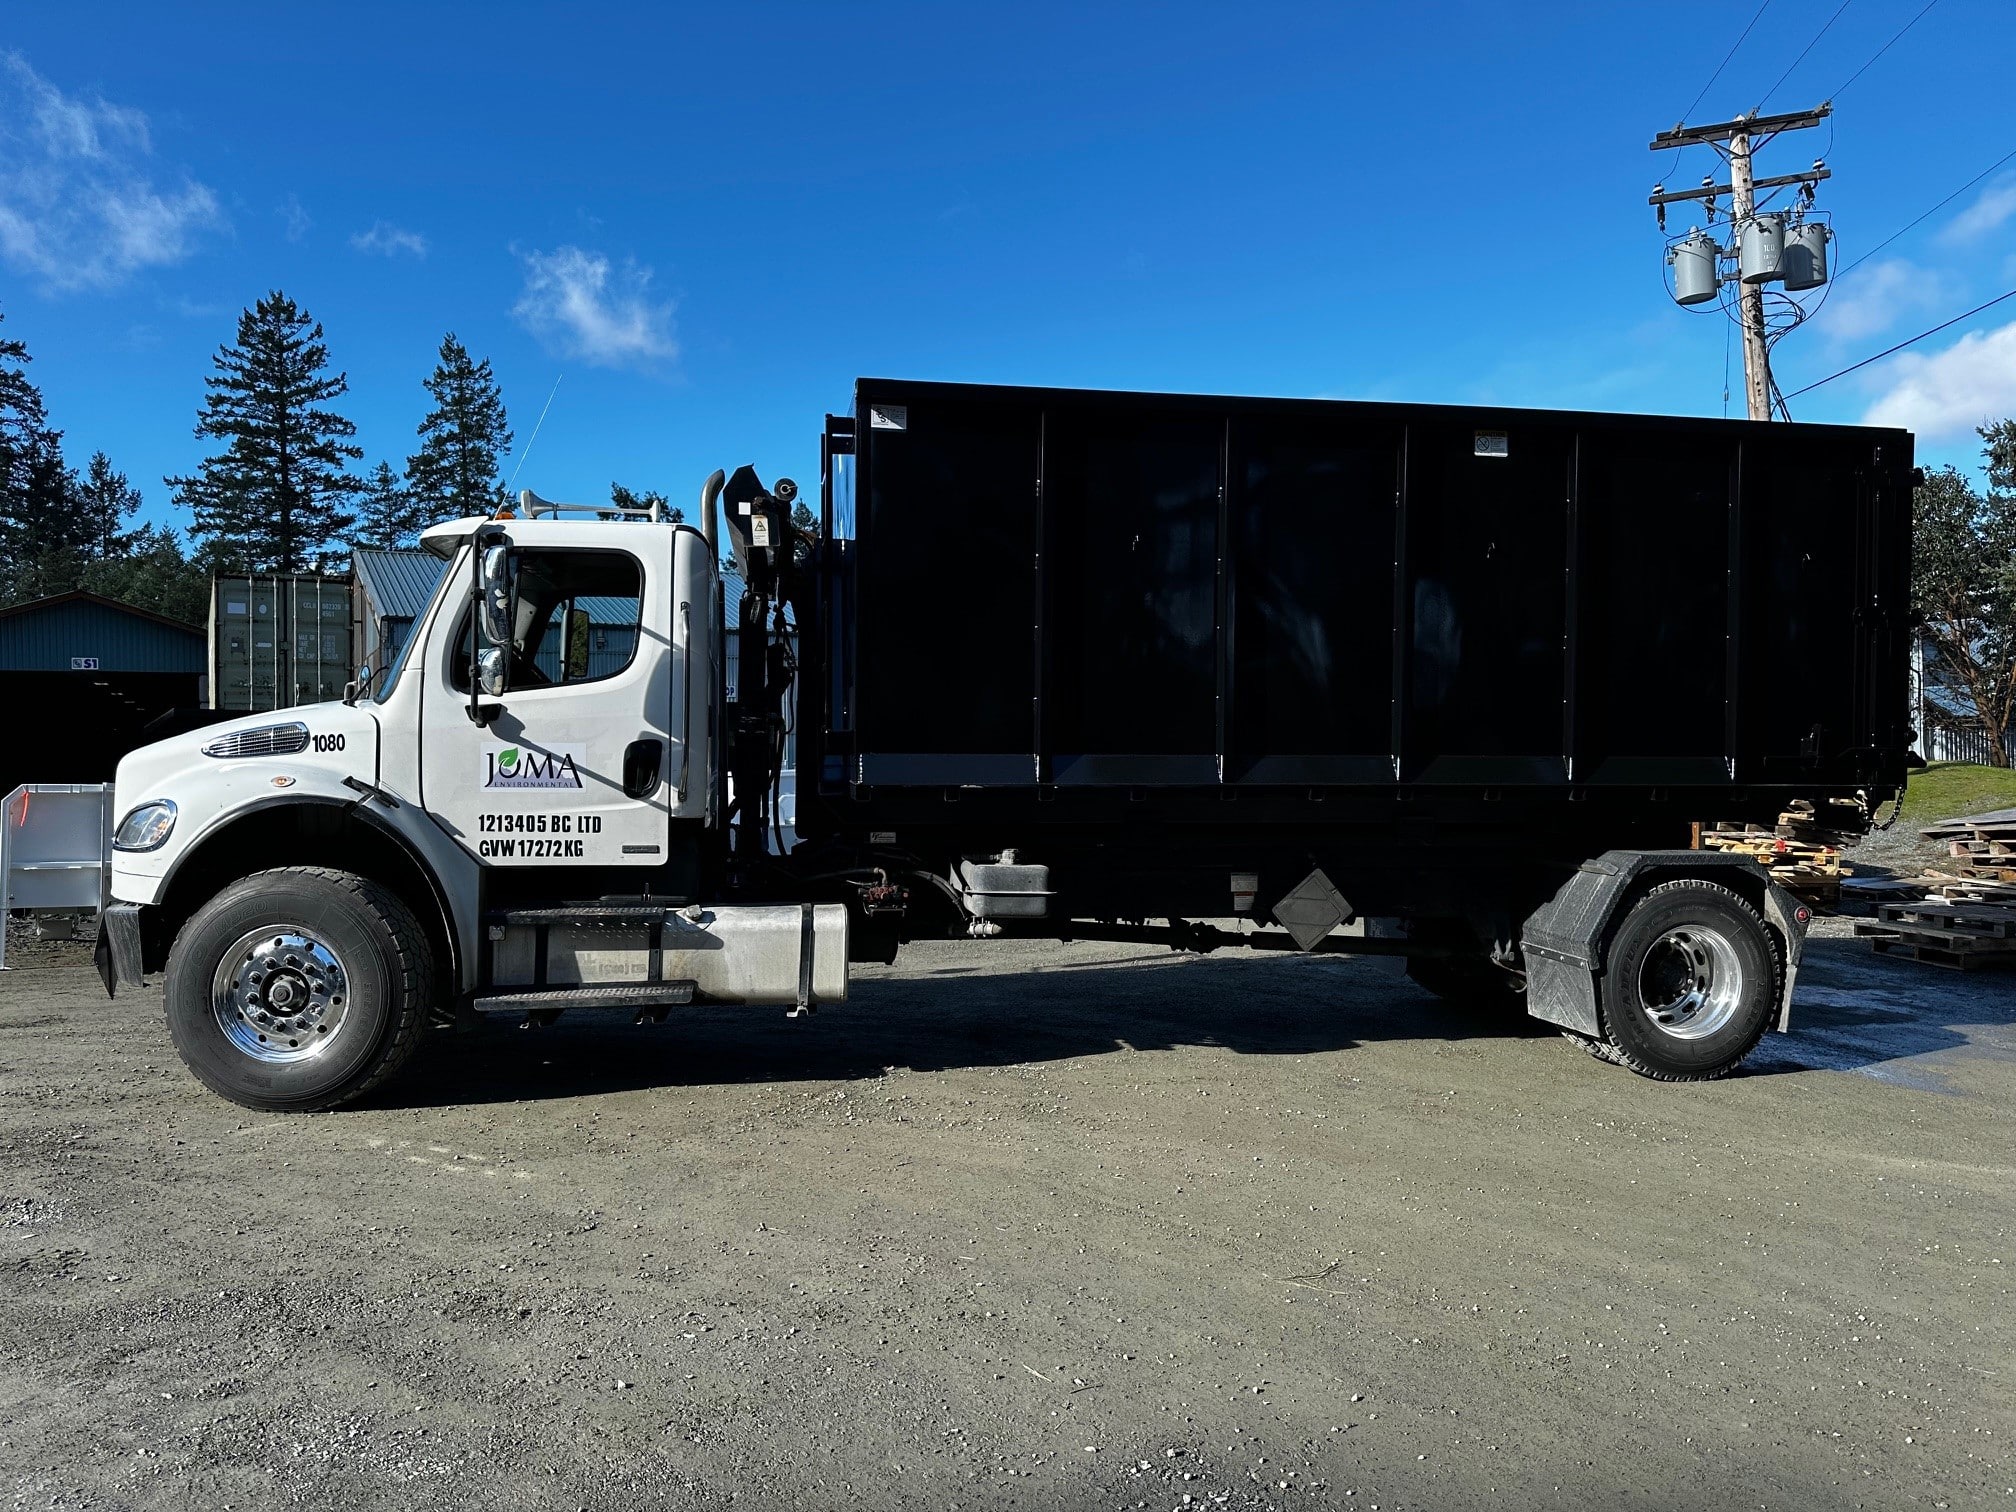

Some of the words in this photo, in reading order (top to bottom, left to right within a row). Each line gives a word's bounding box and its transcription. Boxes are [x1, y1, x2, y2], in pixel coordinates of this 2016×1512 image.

[84, 658, 97, 668] S1
[312, 733, 346, 753] 1080
[485, 750, 584, 788] JOMA
[478, 814, 547, 833] 1213405
[551, 815, 571, 833] BC
[577, 815, 602, 834] LTD
[479, 839, 516, 857] GVW
[518, 839, 563, 857] 17272
[564, 839, 584, 857] KG
